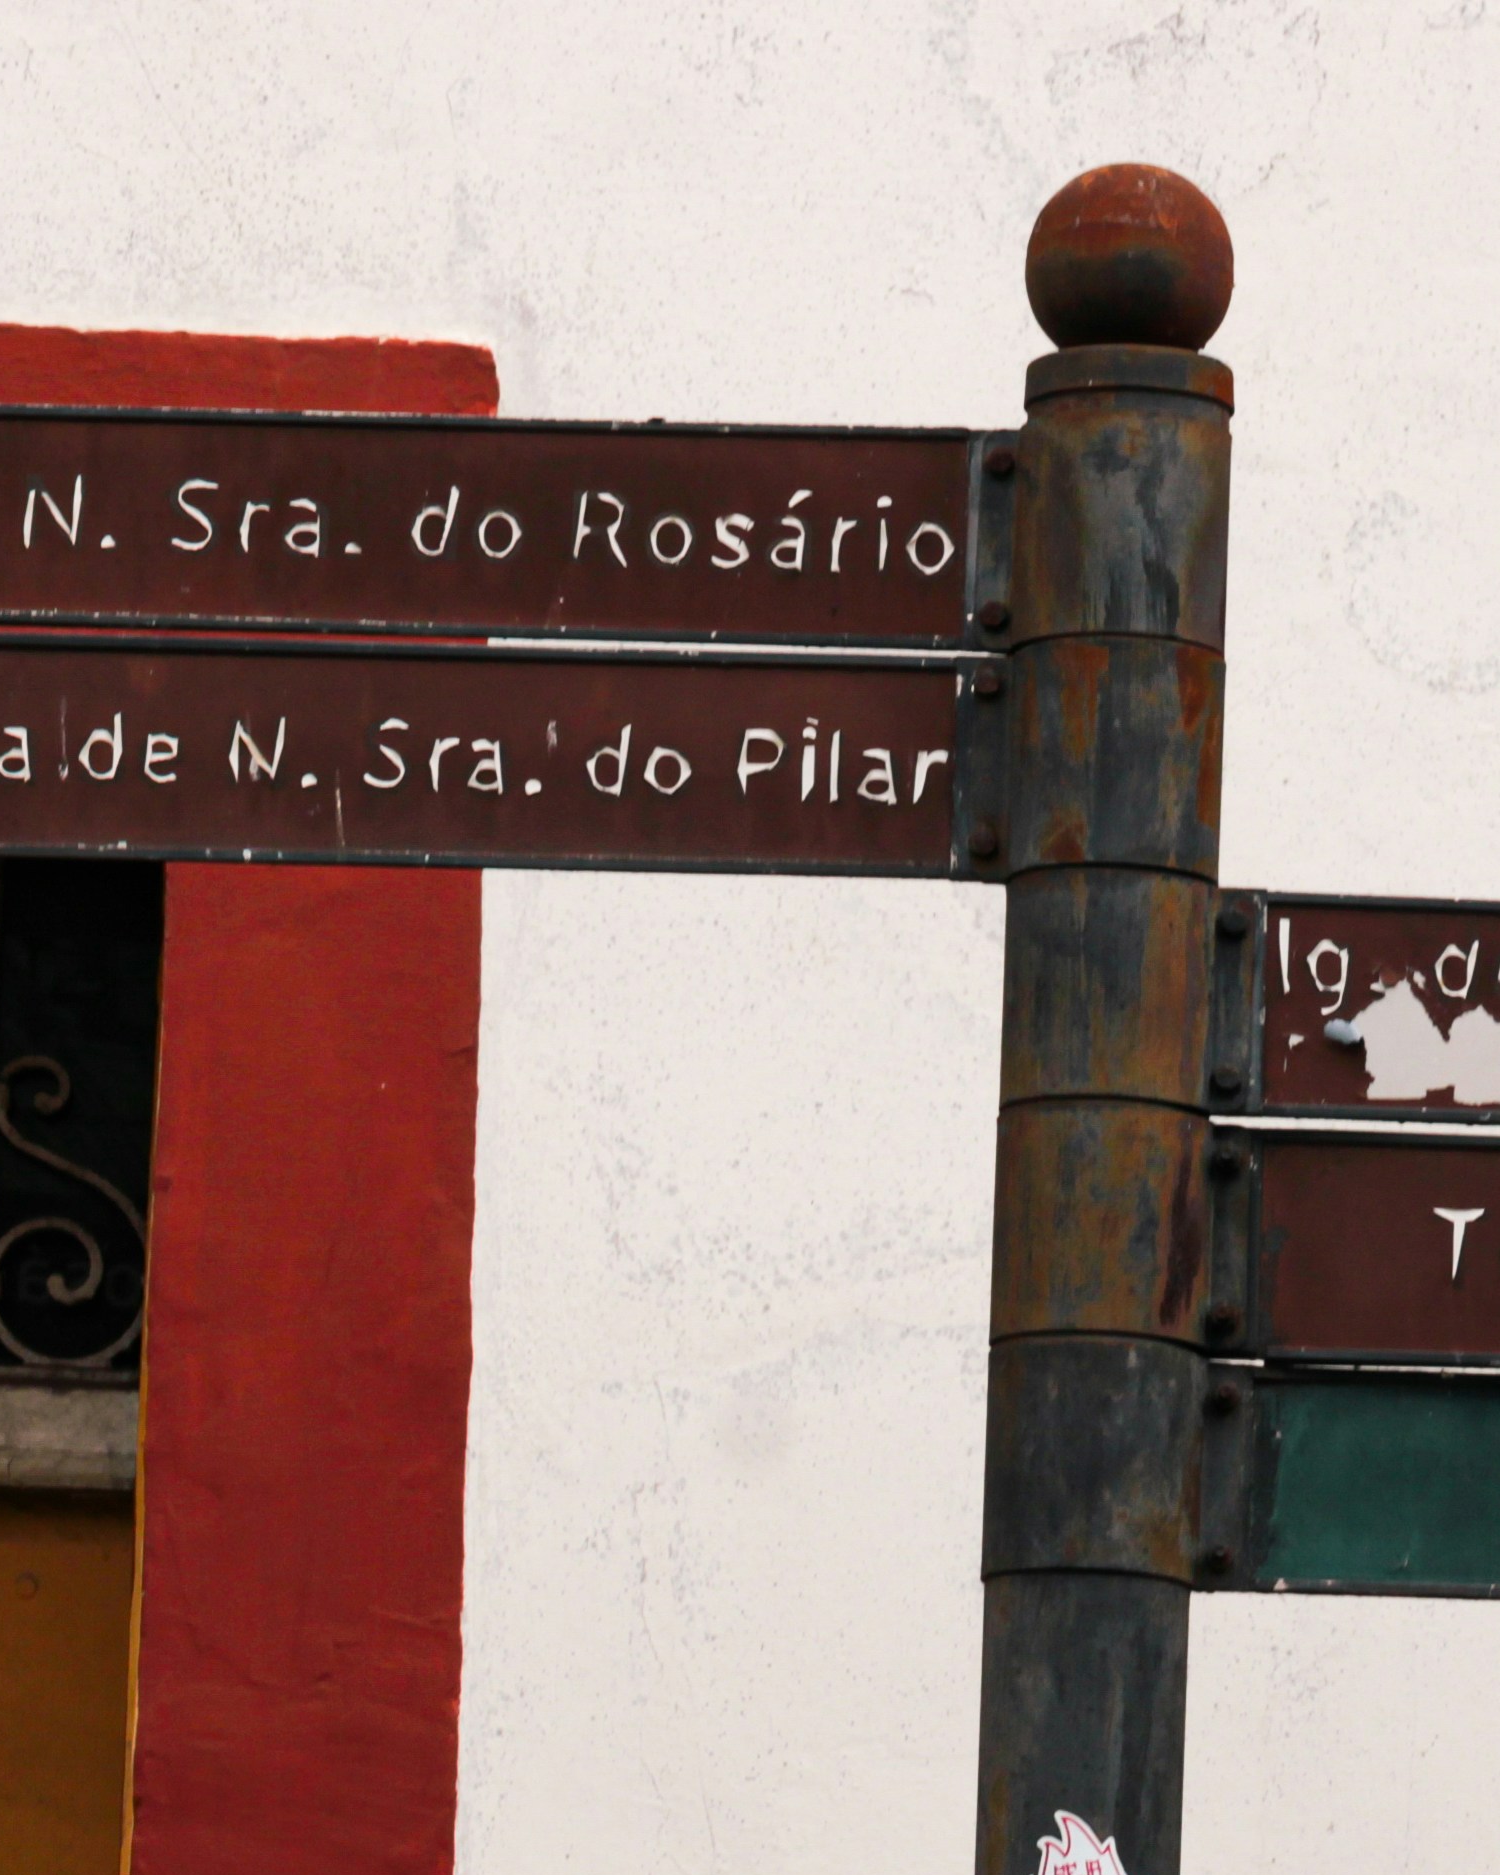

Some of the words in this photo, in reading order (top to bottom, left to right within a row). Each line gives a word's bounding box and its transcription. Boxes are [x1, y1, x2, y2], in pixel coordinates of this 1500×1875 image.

[23, 474, 116, 549] N.
[171, 479, 361, 558] Sra.
[411, 485, 522, 559] do
[573, 489, 955, 576] Rosário
[78, 712, 179, 783] de
[228, 716, 318, 788] N.
[363, 717, 542, 796] Sra.
[586, 723, 692, 796] do
[737, 726, 949, 805] Pilar
